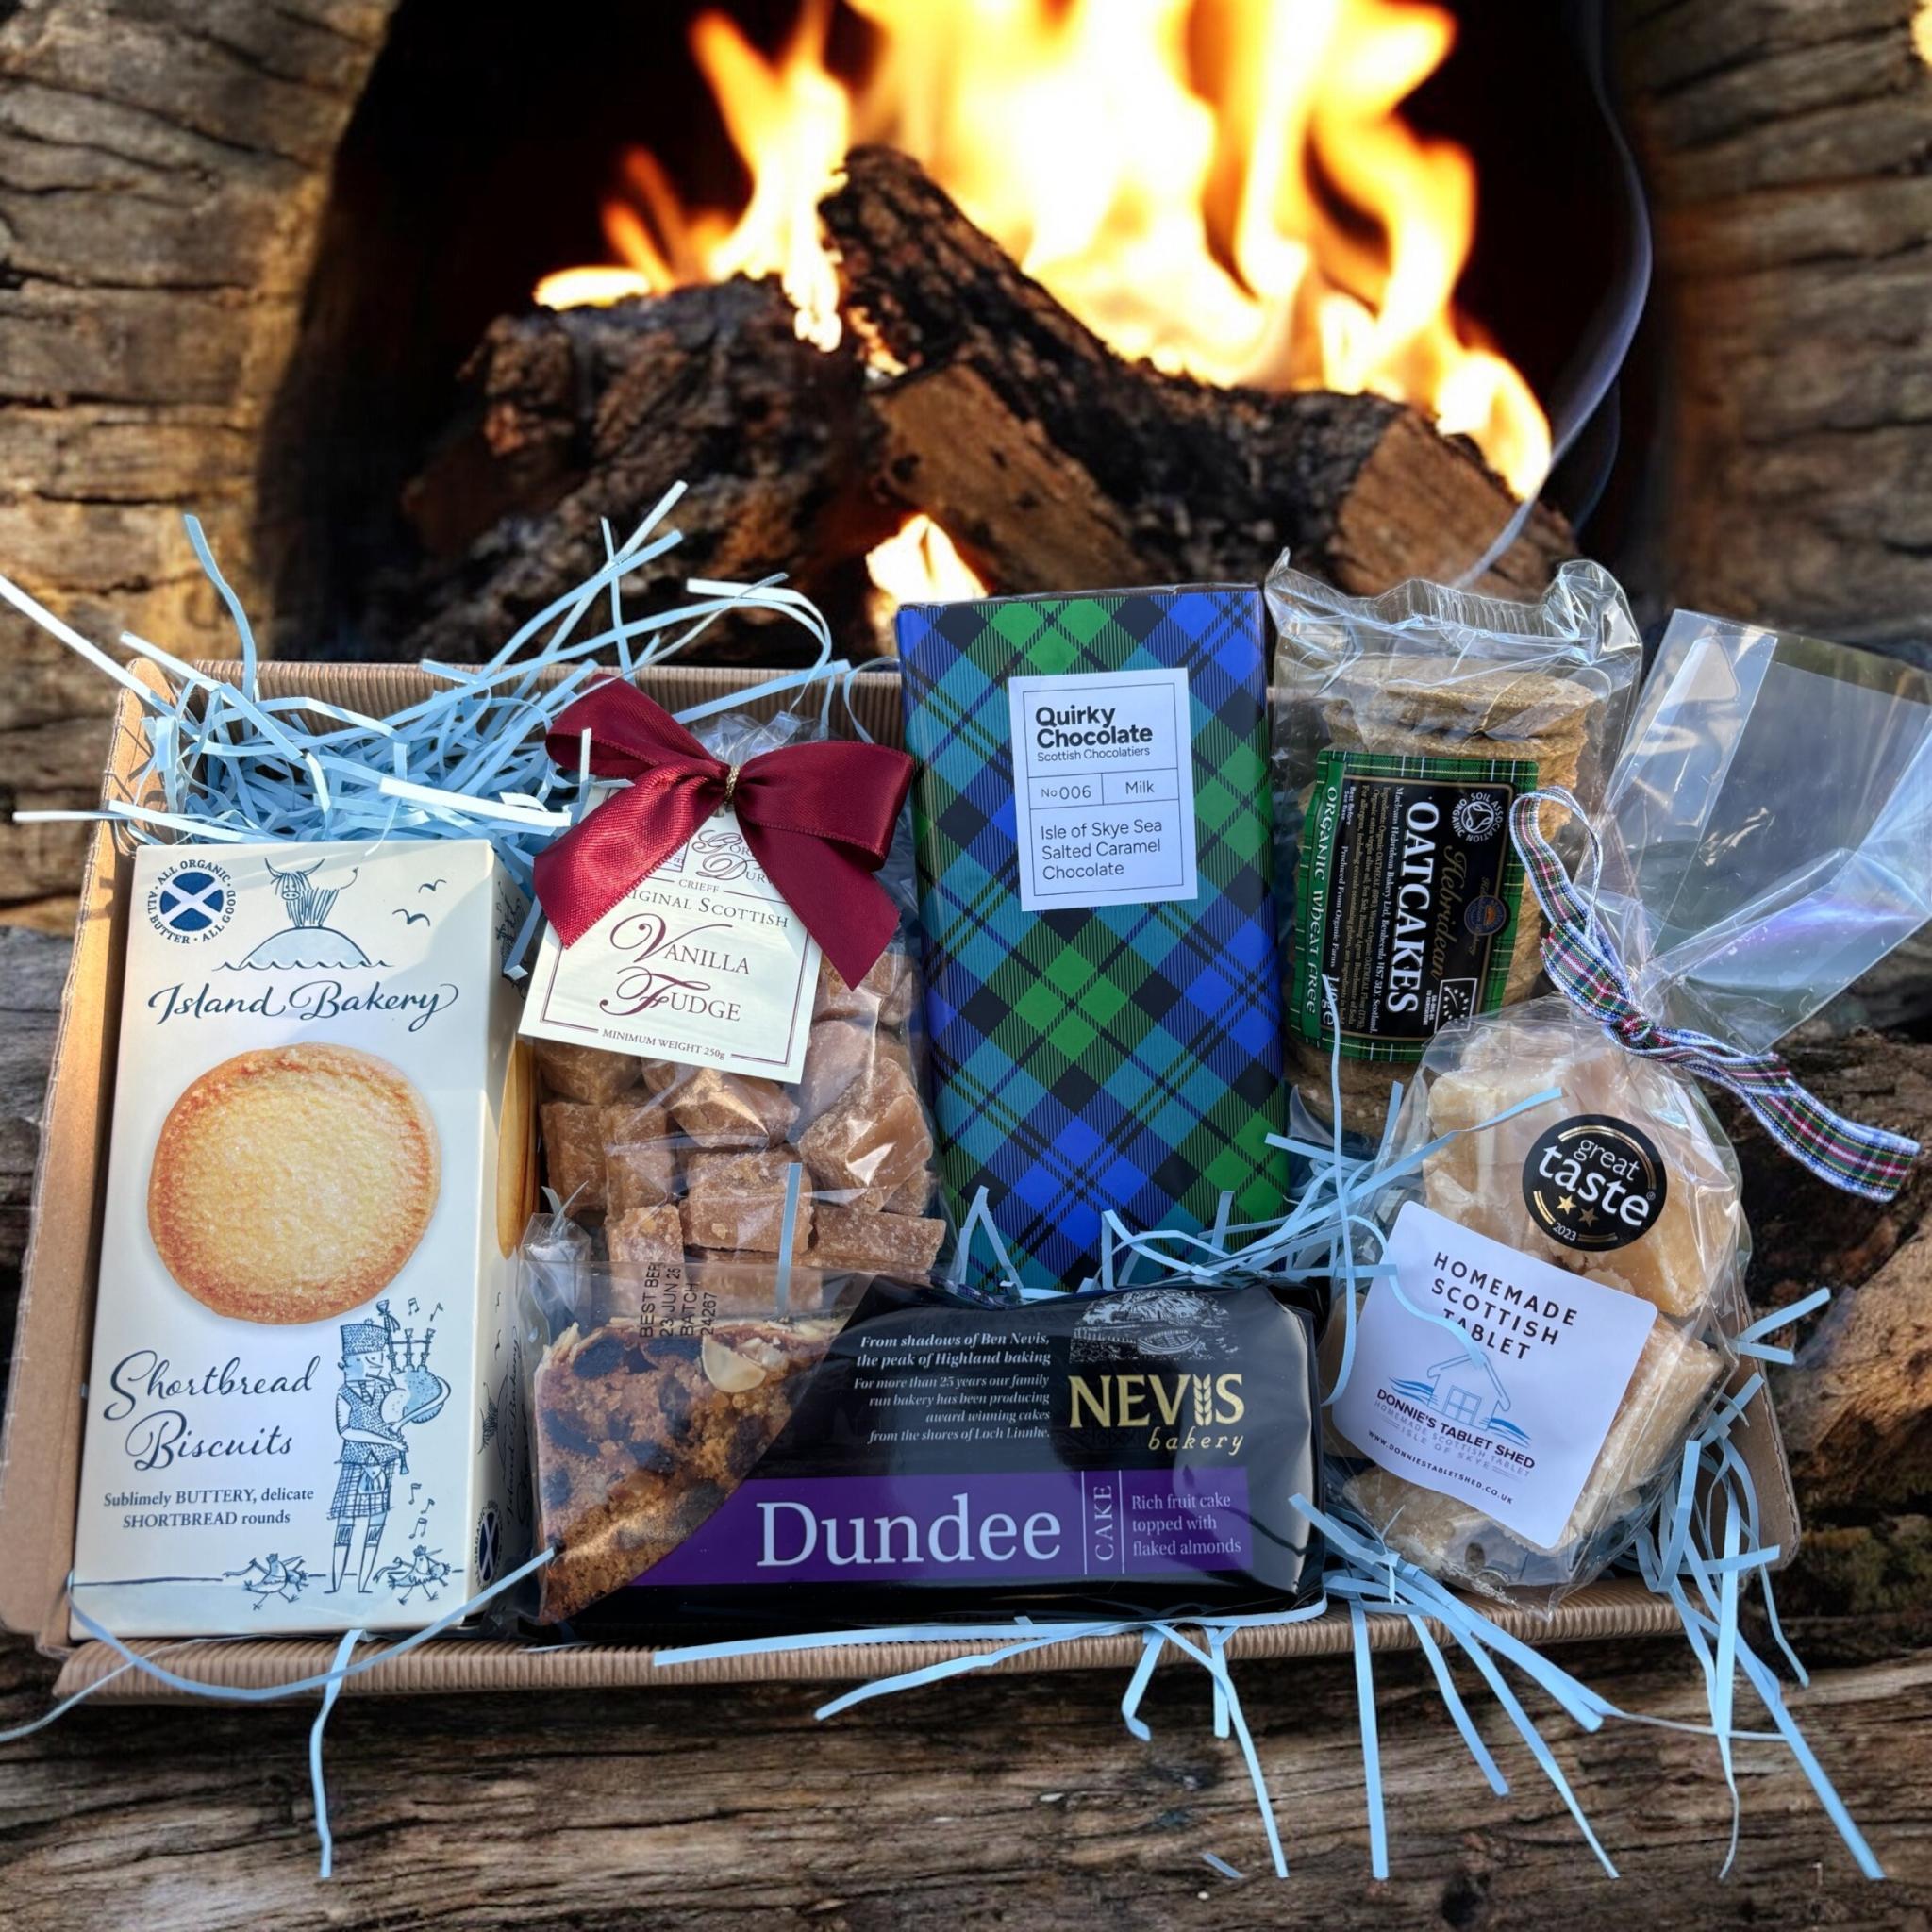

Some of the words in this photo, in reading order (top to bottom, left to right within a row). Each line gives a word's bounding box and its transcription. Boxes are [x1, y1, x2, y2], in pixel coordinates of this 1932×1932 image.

[1035, 705, 1115, 728] Quirky
[1037, 724, 1154, 749] Chocolate
[1037, 750, 1081, 762] Scottish
[1084, 746, 1151, 759] Chocolatiers
[1125, 780, 1155, 795] Milk
[1471, 792, 1490, 803] SOIL
[1393, 787, 1404, 824] Macleans
[1452, 799, 1467, 838] ORGANIC
[1041, 824, 1067, 841] Isle
[1071, 823, 1087, 838] of
[1091, 821, 1129, 839] Skye
[1133, 819, 1163, 834] Sea
[1466, 800, 1503, 843] ASSOCIATION
[1042, 843, 1091, 860] Salted
[1095, 839, 1161, 857] Caramel
[1388, 827, 1399, 869] Hebridean
[158, 866, 178, 885] ALL
[180, 859, 231, 883] ORGANIC
[696, 853, 774, 883] DUR
[1042, 861, 1124, 880] Chocolate
[1339, 846, 1349, 884] Produced
[678, 879, 720, 893] CRIEFF
[1336, 886, 1344, 908] From
[1382, 872, 1395, 897] Bakery
[148, 891, 158, 914] ALL
[202, 924, 225, 942] ALL
[222, 890, 236, 923] GOOD
[627, 889, 692, 910] IGINAL
[698, 896, 790, 928] SCOTTISH
[1386, 802, 1440, 1012] OATCAKES
[1430, 845, 1467, 981] Hebridean
[149, 914, 191, 944] BUTTER
[1333, 910, 1342, 941] Organic
[609, 913, 751, 975] VANILLA
[1330, 943, 1339, 967] Farms
[147, 982, 286, 1025] Island
[289, 980, 459, 1032] Bakery
[599, 966, 741, 1023] FUDGE
[602, 1028, 657, 1047] MINIMUM
[658, 1039, 703, 1055] WEIGHT
[704, 1047, 726, 1060] 250g
[1574, 1140, 1641, 1181] great
[1539, 1145, 1650, 1226] taste
[1553, 1222, 1577, 1241] 2023
[665, 1268, 681, 1279] 25
[1433, 1251, 1577, 1326] HOMEMADE
[662, 1283, 678, 1312] JUN
[680, 1283, 698, 1336] BATCH
[1431, 1277, 1558, 1345] SCOTTISH
[640, 1292, 656, 1338] BEST
[659, 1318, 674, 1336] 23
[701, 1292, 717, 1335] 24267
[860, 1336, 897, 1348] From
[900, 1333, 961, 1347] shadows
[964, 1334, 979, 1349] of
[981, 1332, 1007, 1345] Ben
[1009, 1332, 1050, 1345] Nevis,
[857, 1354, 878, 1367] the
[881, 1353, 915, 1369] peak
[918, 1353, 933, 1368] of
[935, 1351, 1001, 1368] Highland
[1003, 1351, 1051, 1366] baking
[103, 1349, 321, 1421] Shortbread
[854, 1377, 874, 1389] For
[876, 1379, 907, 1389] more
[909, 1376, 937, 1388] than
[940, 1376, 954, 1388] 25
[956, 1377, 987, 1390] years
[989, 1377, 1008, 1386] our
[1009, 1374, 1050, 1389] family
[869, 1397, 891, 1407] run
[893, 1394, 934, 1408] bakery
[937, 1393, 958, 1405] has
[959, 1392, 987, 1404] been
[989, 1391, 1050, 1407] producing
[1068, 1374, 1245, 1428] NEVIS
[925, 1410, 965, 1423] award
[968, 1410, 1016, 1424] winning
[1018, 1408, 1050, 1421] cakes
[1377, 1388, 1437, 1428] DONNIE'S
[1440, 1423, 1493, 1450] TABLET
[1494, 1443, 1536, 1470] SHED
[125, 1409, 293, 1471] Biscuits
[867, 1429, 897, 1444] from
[901, 1428, 920, 1441] the
[922, 1428, 958, 1441] shores
[960, 1428, 974, 1441] of
[974, 1427, 1003, 1440] Loch
[1006, 1426, 1050, 1439] Linnhe.
[1147, 1425, 1244, 1456] bakery
[1374, 1400, 1427, 1435] HOMEMADE
[1431, 1432, 1486, 1458] SCOTTISH
[1491, 1455, 1530, 1478] TABLET
[1401, 1426, 1426, 1445] ISLE
[1434, 1442, 1451, 1454] OF
[1457, 1452, 1490, 1469] SKYE
[104, 1491, 171, 1507] Sublimely
[175, 1488, 257, 1504] BUTTERY,
[261, 1486, 314, 1501] delicate
[1132, 1494, 1163, 1509] Rich
[1167, 1492, 1197, 1508] fruit
[1199, 1492, 1231, 1508] cake
[123, 1511, 238, 1528] SHORTBREAD
[242, 1509, 291, 1525] rounds
[756, 1492, 1062, 1567] Dundee
[1093, 1485, 1114, 1561] CAKE
[1132, 1517, 1182, 1539] topped
[1186, 1515, 1217, 1530] with
[1132, 1540, 1176, 1557] flaked
[1179, 1537, 1241, 1555] almonds
